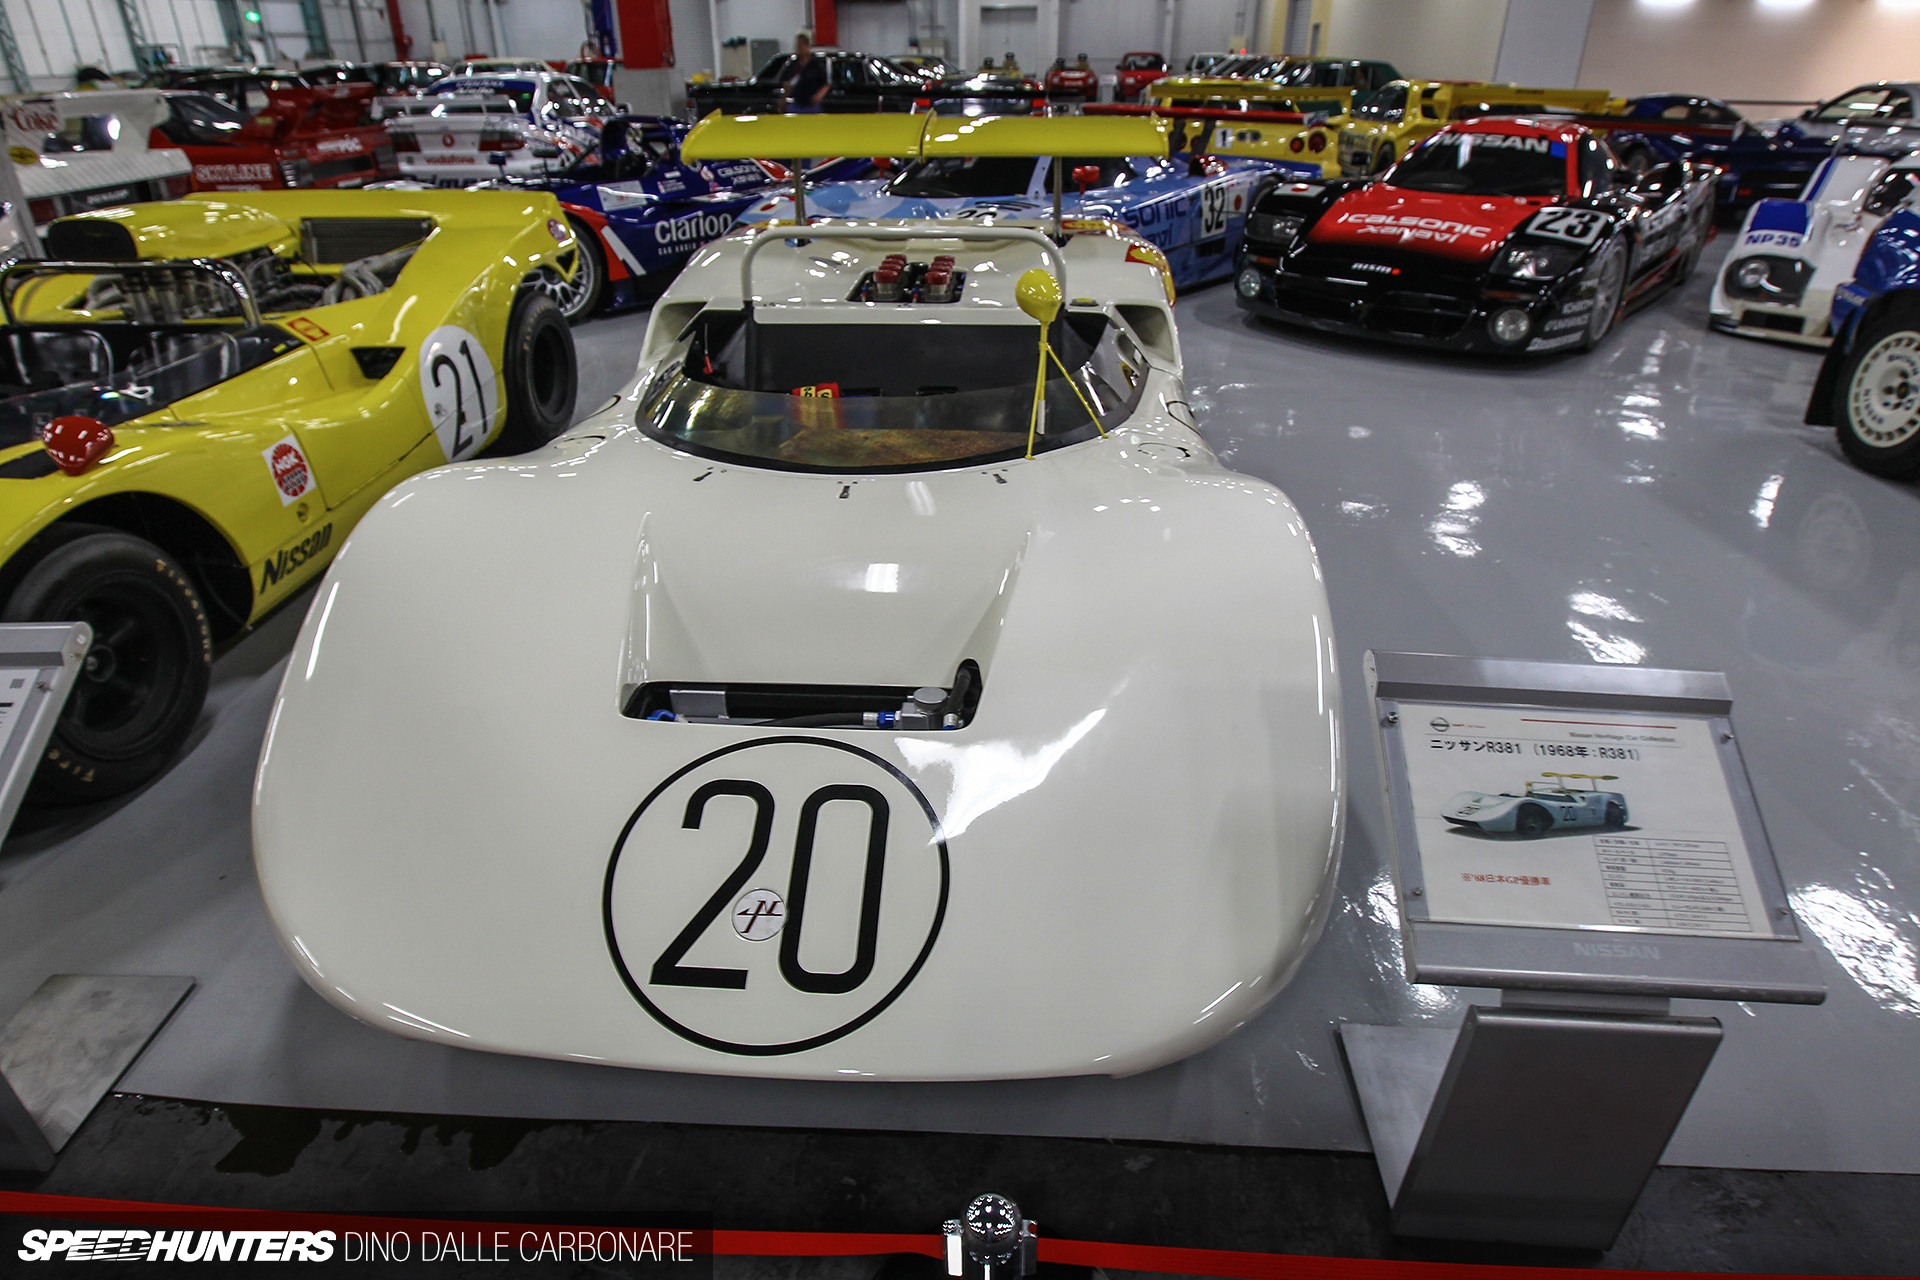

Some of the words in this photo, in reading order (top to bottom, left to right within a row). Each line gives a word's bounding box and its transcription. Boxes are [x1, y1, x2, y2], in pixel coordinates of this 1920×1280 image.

[1440, 132, 1549, 154] NISSAN
[655, 211, 732, 244] Clarion
[1204, 184, 1225, 232] 32
[1534, 210, 1600, 238] 23
[431, 340, 487, 458] 21
[260, 523, 332, 594] Nissan
[650, 779, 889, 994] 20
[1573, 942, 1661, 960] NISSAN
